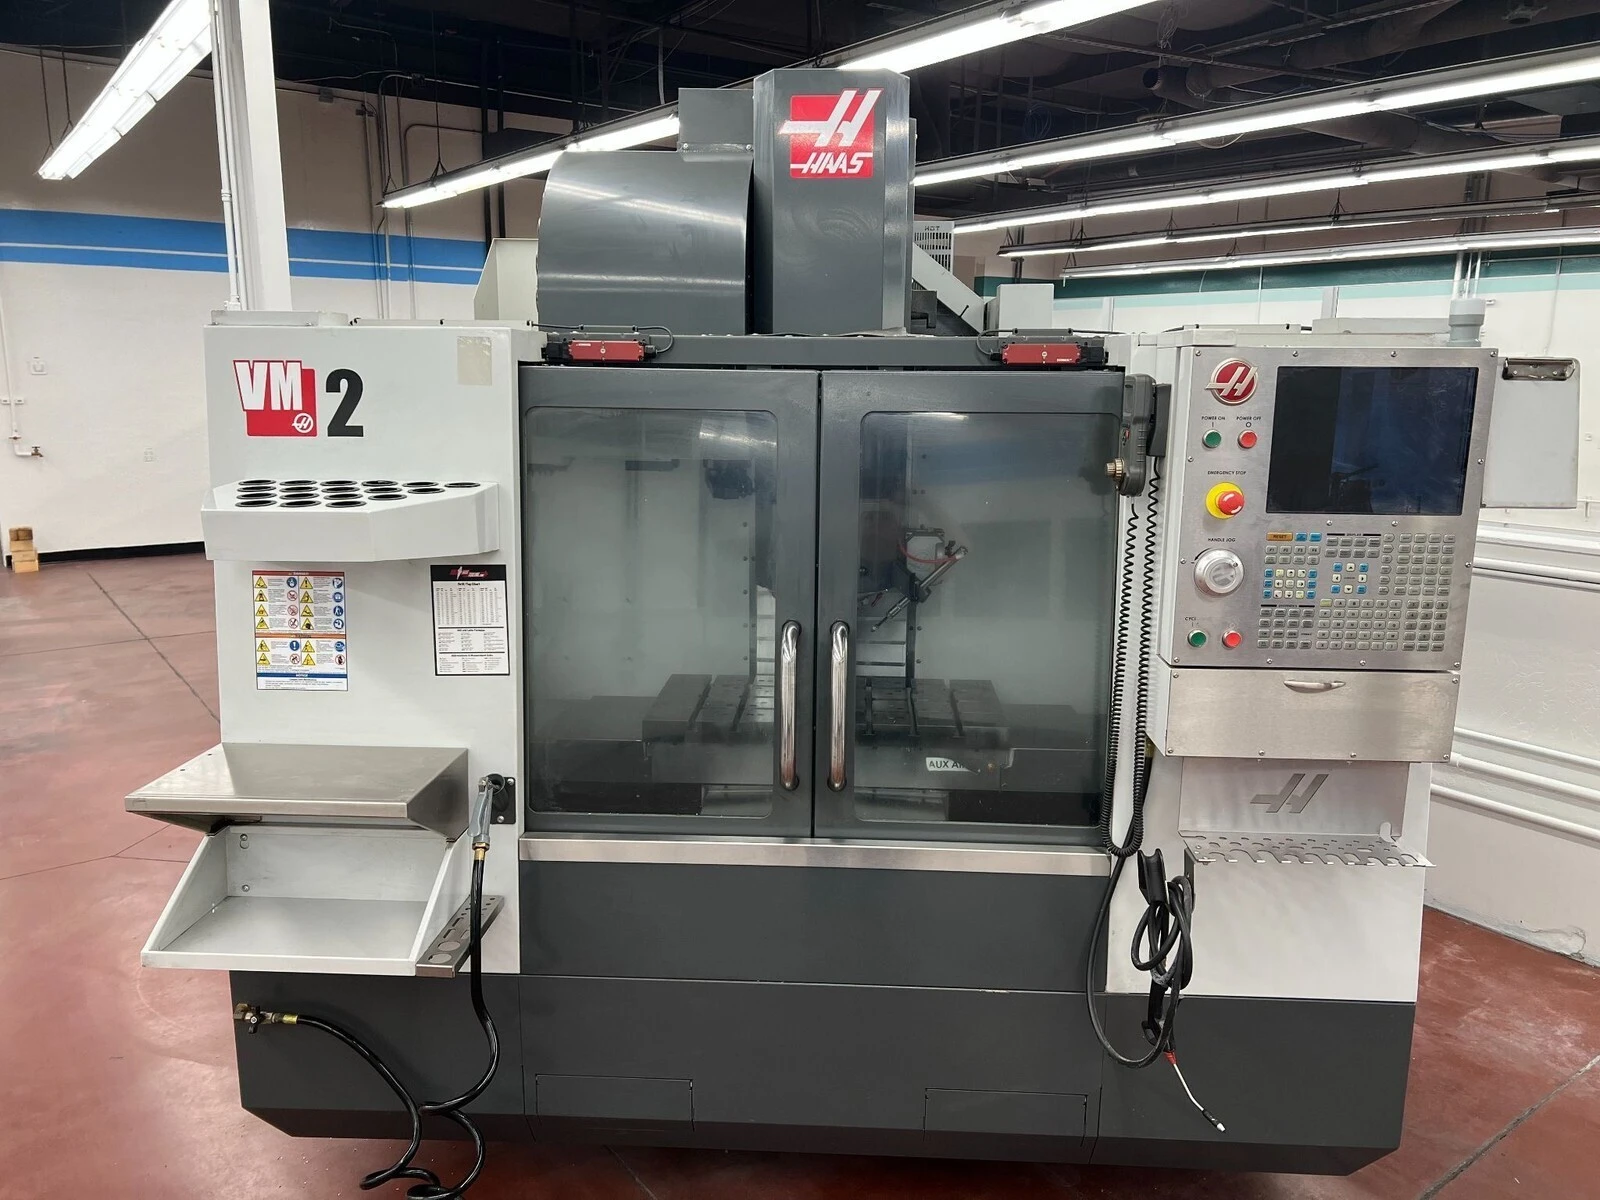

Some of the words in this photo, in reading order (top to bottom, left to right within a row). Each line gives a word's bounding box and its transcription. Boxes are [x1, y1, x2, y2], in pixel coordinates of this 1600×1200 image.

[790, 151, 873, 174] HAAS
[233, 360, 303, 411] VM
[325, 368, 364, 437] 2
[929, 760, 949, 769] AUX
